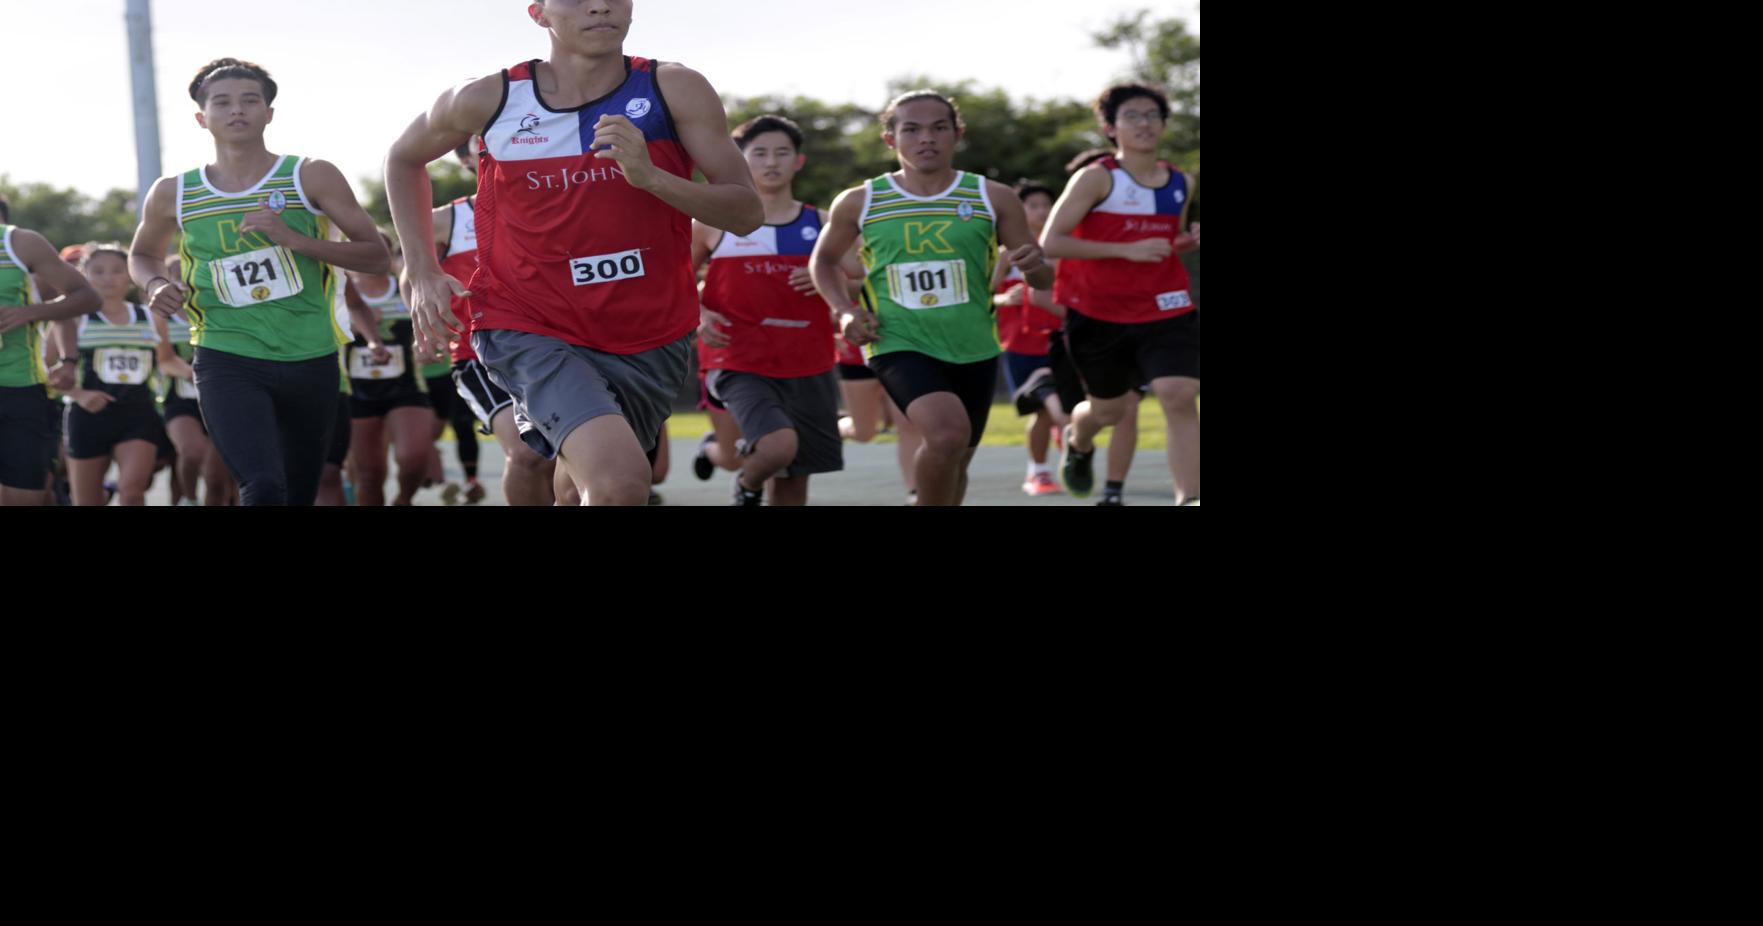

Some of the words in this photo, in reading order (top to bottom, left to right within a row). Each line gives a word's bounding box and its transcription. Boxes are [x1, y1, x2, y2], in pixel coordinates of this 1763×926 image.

[511, 135, 549, 145] Knights
[904, 221, 955, 254] K
[231, 258, 277, 287] 121
[574, 255, 640, 283] 300
[905, 269, 947, 292] 101
